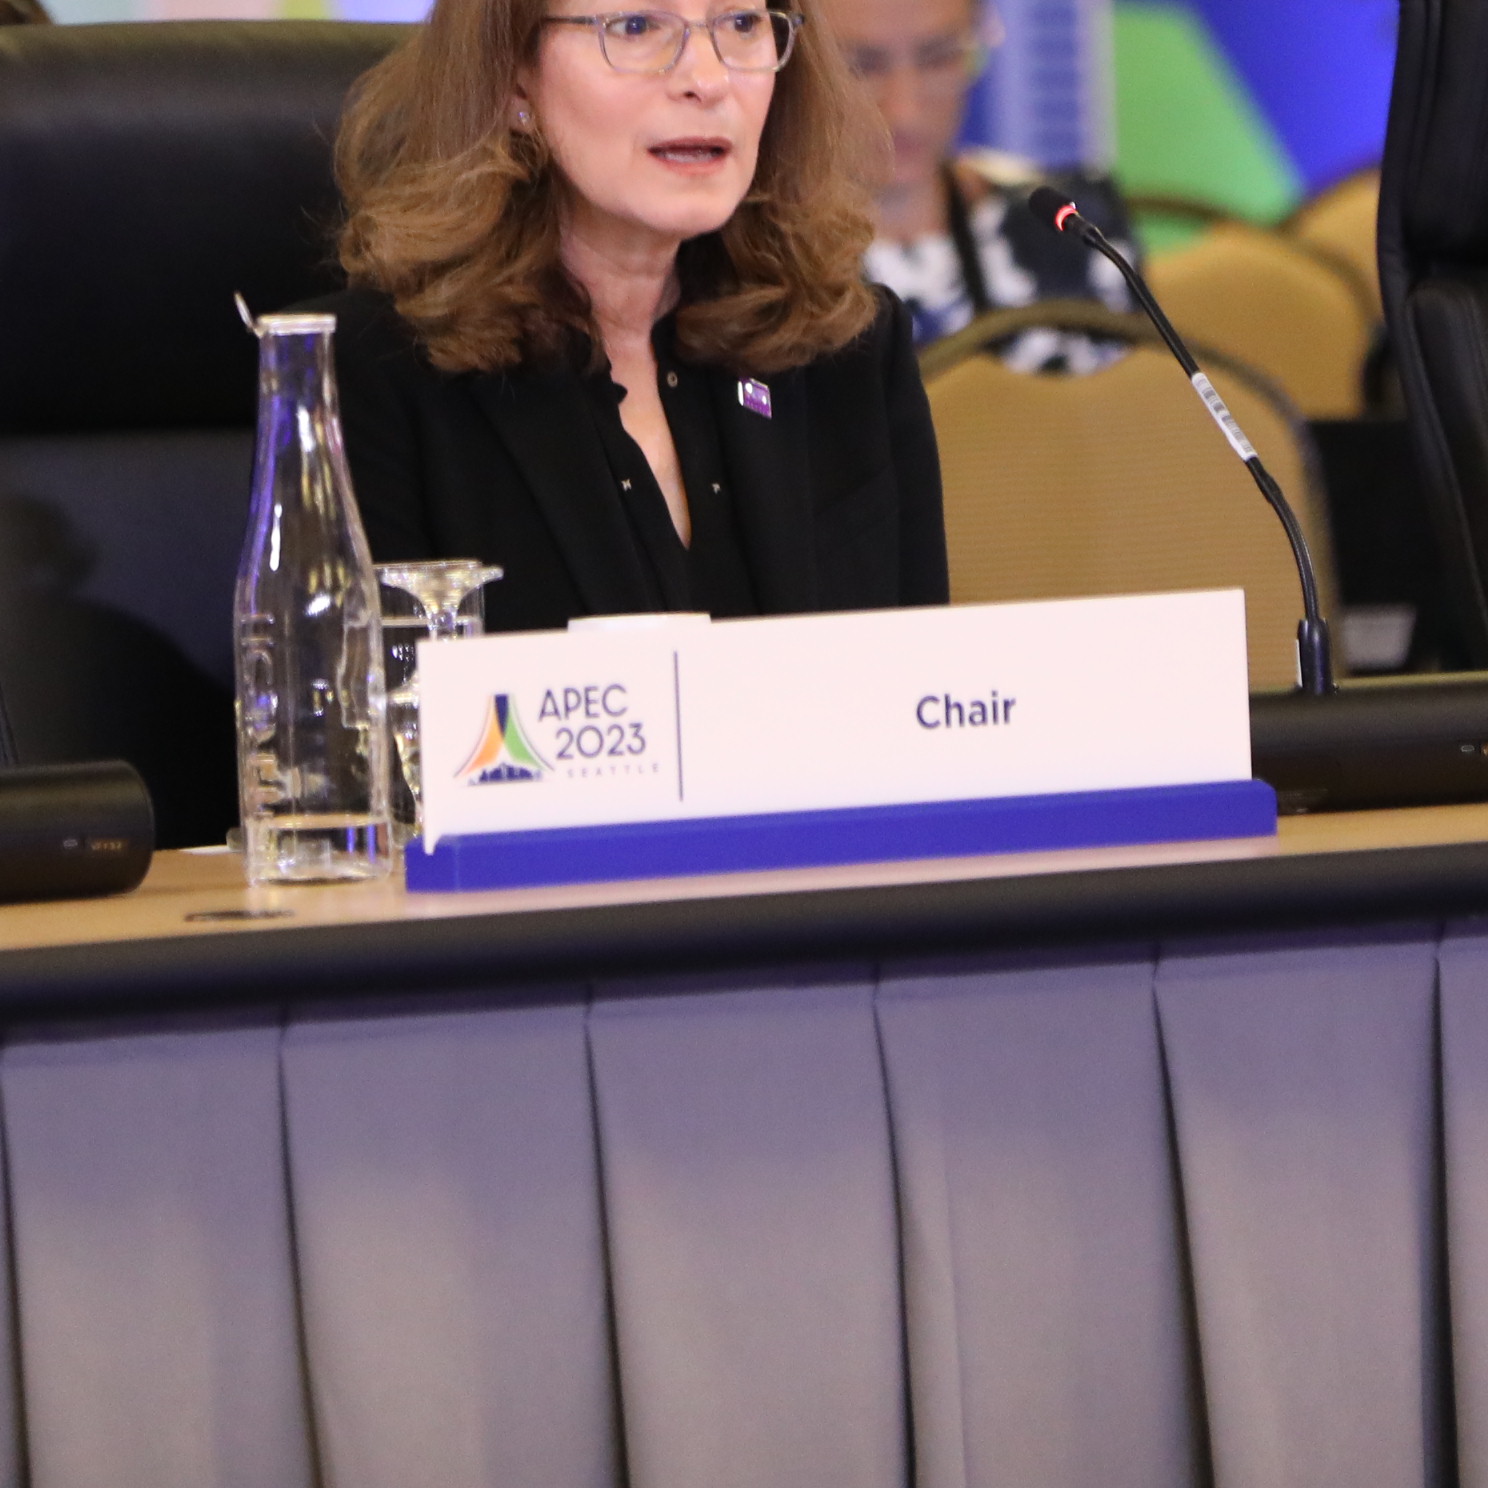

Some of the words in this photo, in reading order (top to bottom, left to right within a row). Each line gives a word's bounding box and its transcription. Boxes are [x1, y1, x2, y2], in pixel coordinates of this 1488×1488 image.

[538, 683, 629, 722] APEC
[916, 690, 1016, 730] Chair
[555, 722, 646, 761] 2023
